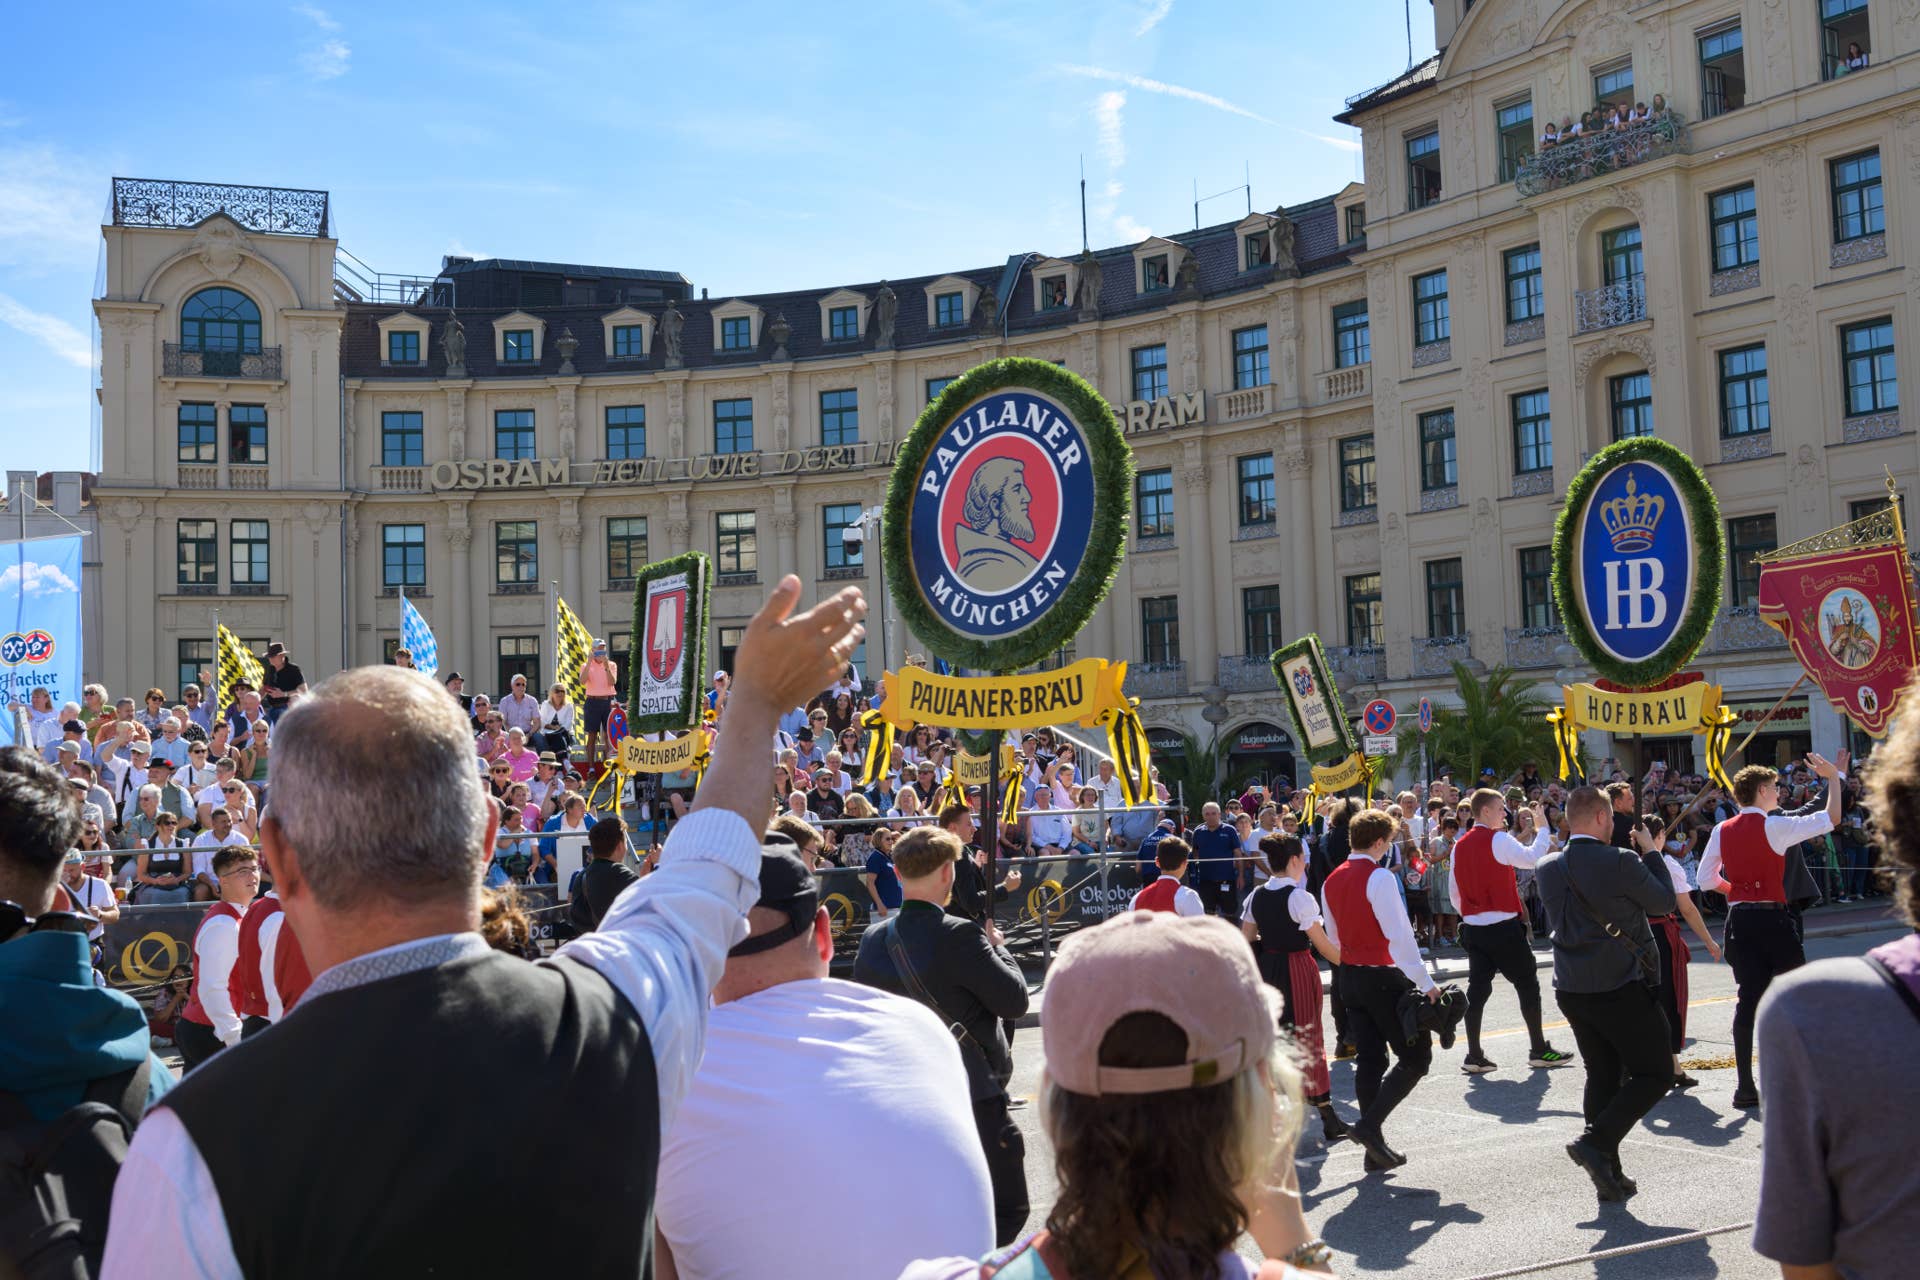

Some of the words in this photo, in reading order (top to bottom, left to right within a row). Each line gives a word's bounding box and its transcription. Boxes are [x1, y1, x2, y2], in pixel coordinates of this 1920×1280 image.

[1111, 389, 1206, 434] SRAM
[431, 456, 571, 490] OSRAM
[592, 457, 670, 485] HELL
[688, 452, 761, 480] WIE
[780, 447, 851, 474] DER
[921, 400, 1082, 498] PAULANER
[930, 559, 1067, 626] MÜNCHEN
[1602, 557, 1668, 630] HB
[0, 670, 58, 691] Hacker
[641, 694, 682, 714] SPATEN
[1587, 695, 1687, 726] HOFBRÄU
[1240, 733, 1287, 745] Hugendubel
